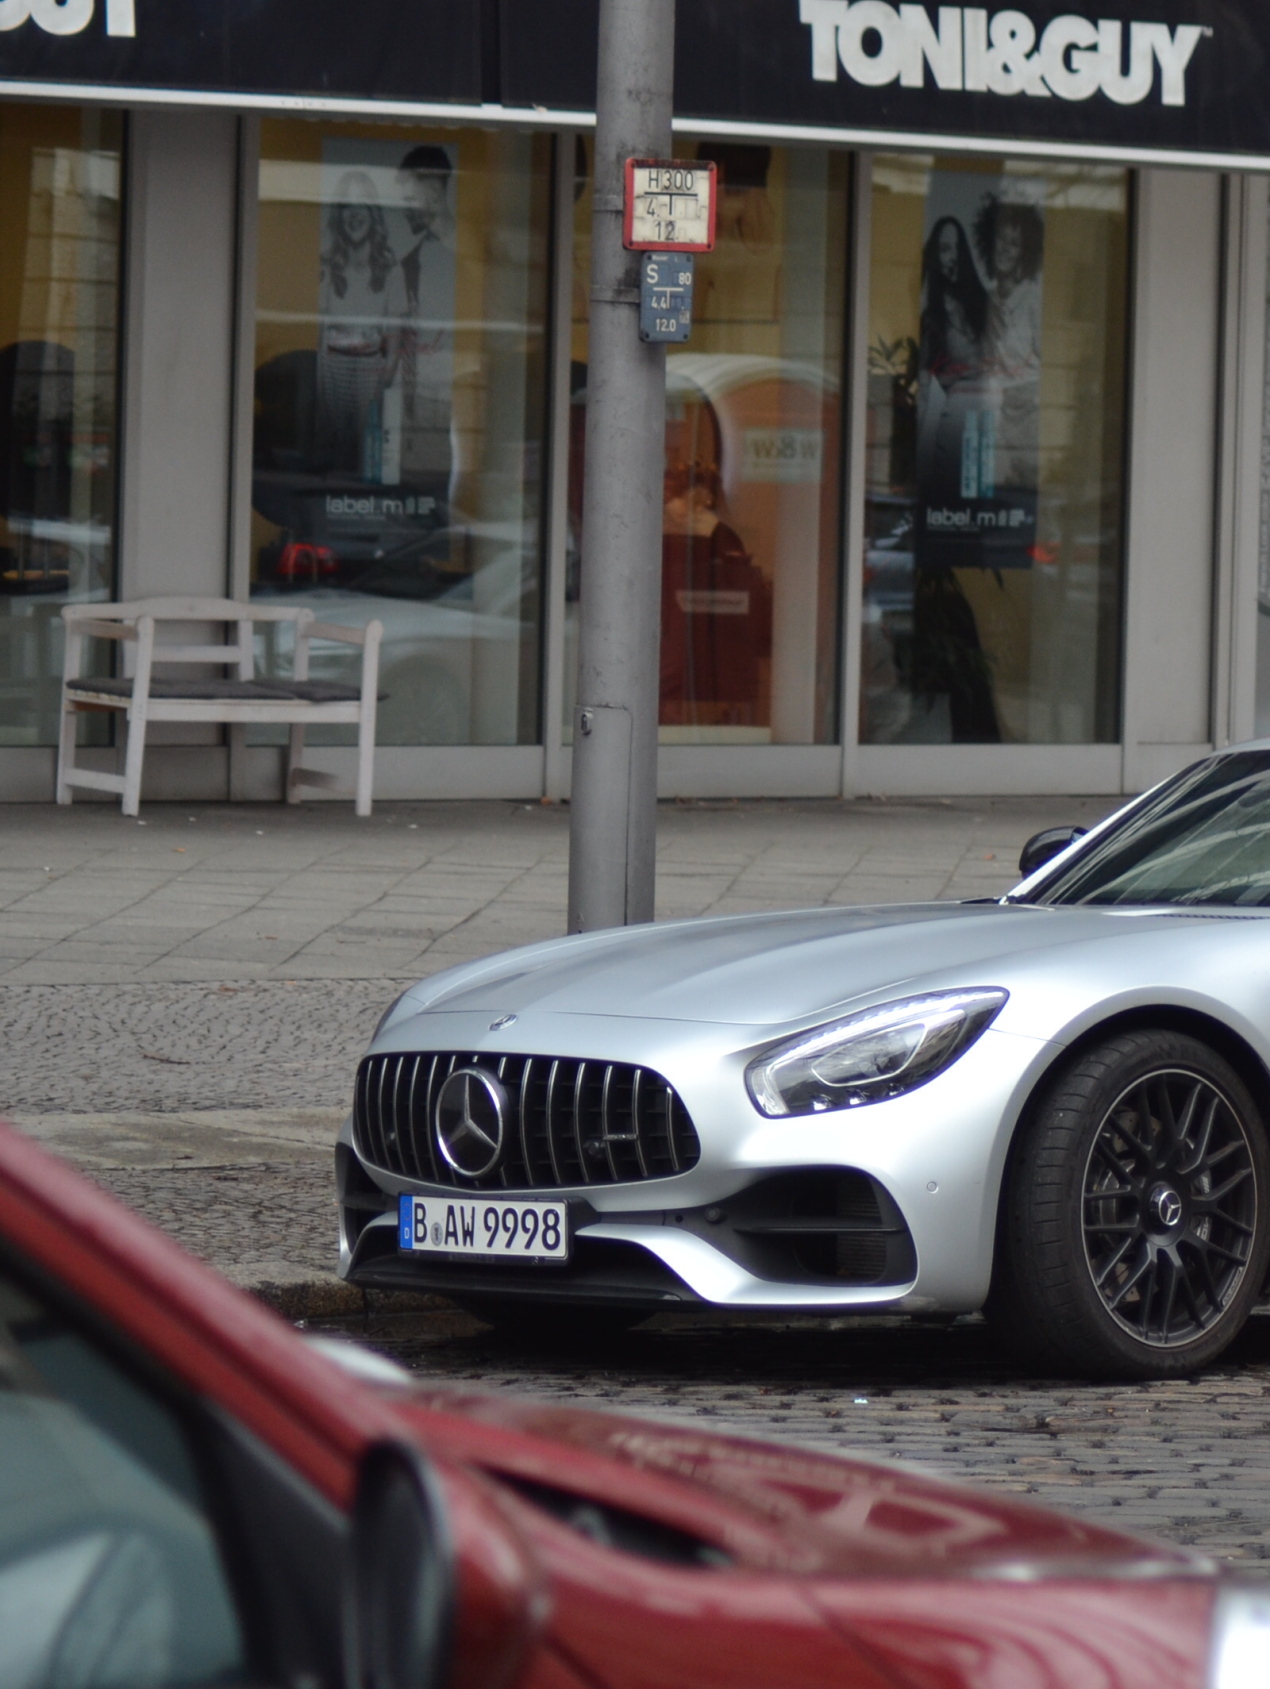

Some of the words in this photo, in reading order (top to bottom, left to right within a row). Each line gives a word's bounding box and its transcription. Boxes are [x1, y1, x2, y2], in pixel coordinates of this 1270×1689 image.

[646, 264, 659, 284] S
[678, 272, 692, 285] 80
[655, 318, 677, 332] 12.0
[414, 1202, 428, 1243] B
[444, 1204, 476, 1247] AW
[483, 1206, 561, 1251] 9998
